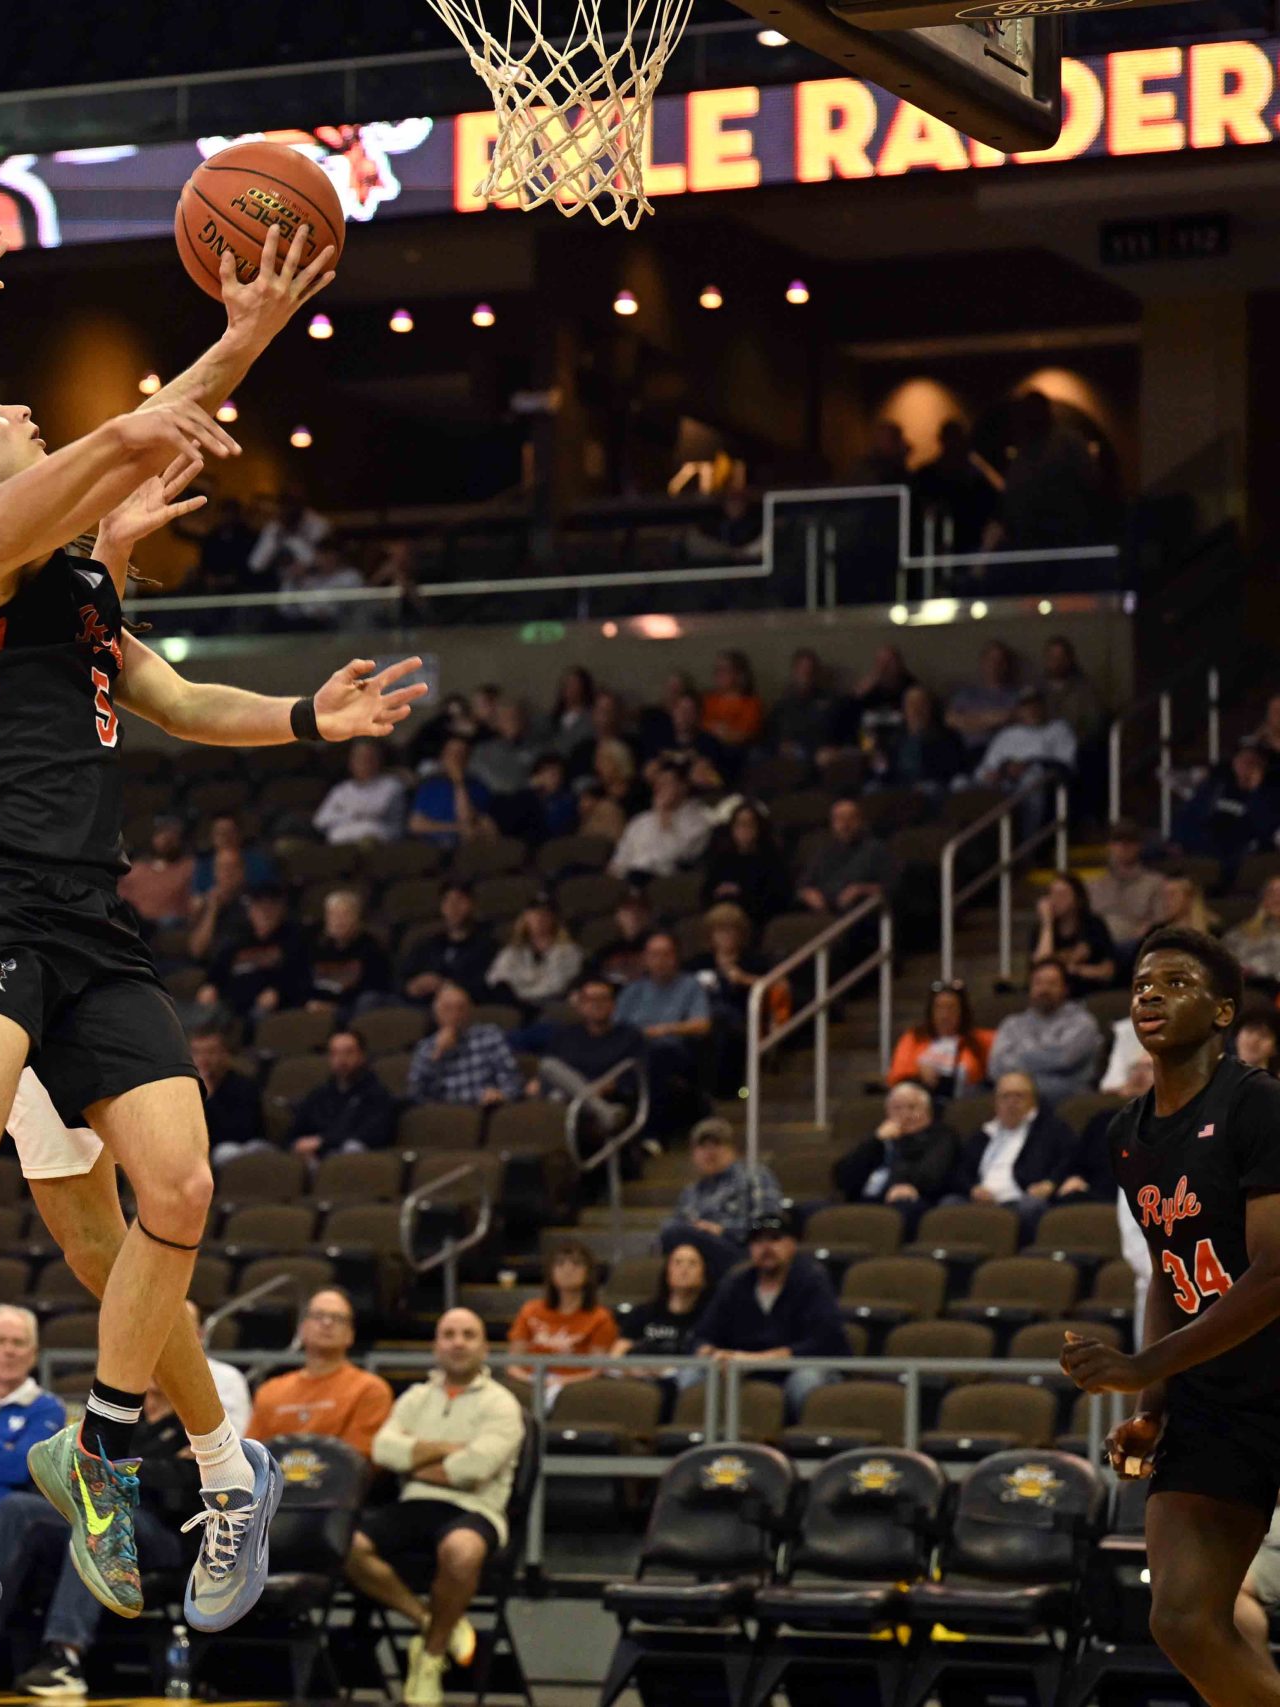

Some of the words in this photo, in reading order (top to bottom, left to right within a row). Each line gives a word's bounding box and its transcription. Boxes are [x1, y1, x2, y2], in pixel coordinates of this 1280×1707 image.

[993, 0, 1103, 16] Ford
[455, 86, 761, 213] RYLE
[794, 40, 1280, 181] RADER
[231, 194, 317, 257] LGACY
[91, 666, 118, 748] 5
[1137, 1175, 1202, 1236] Ryle
[1162, 1238, 1233, 1315] 34
